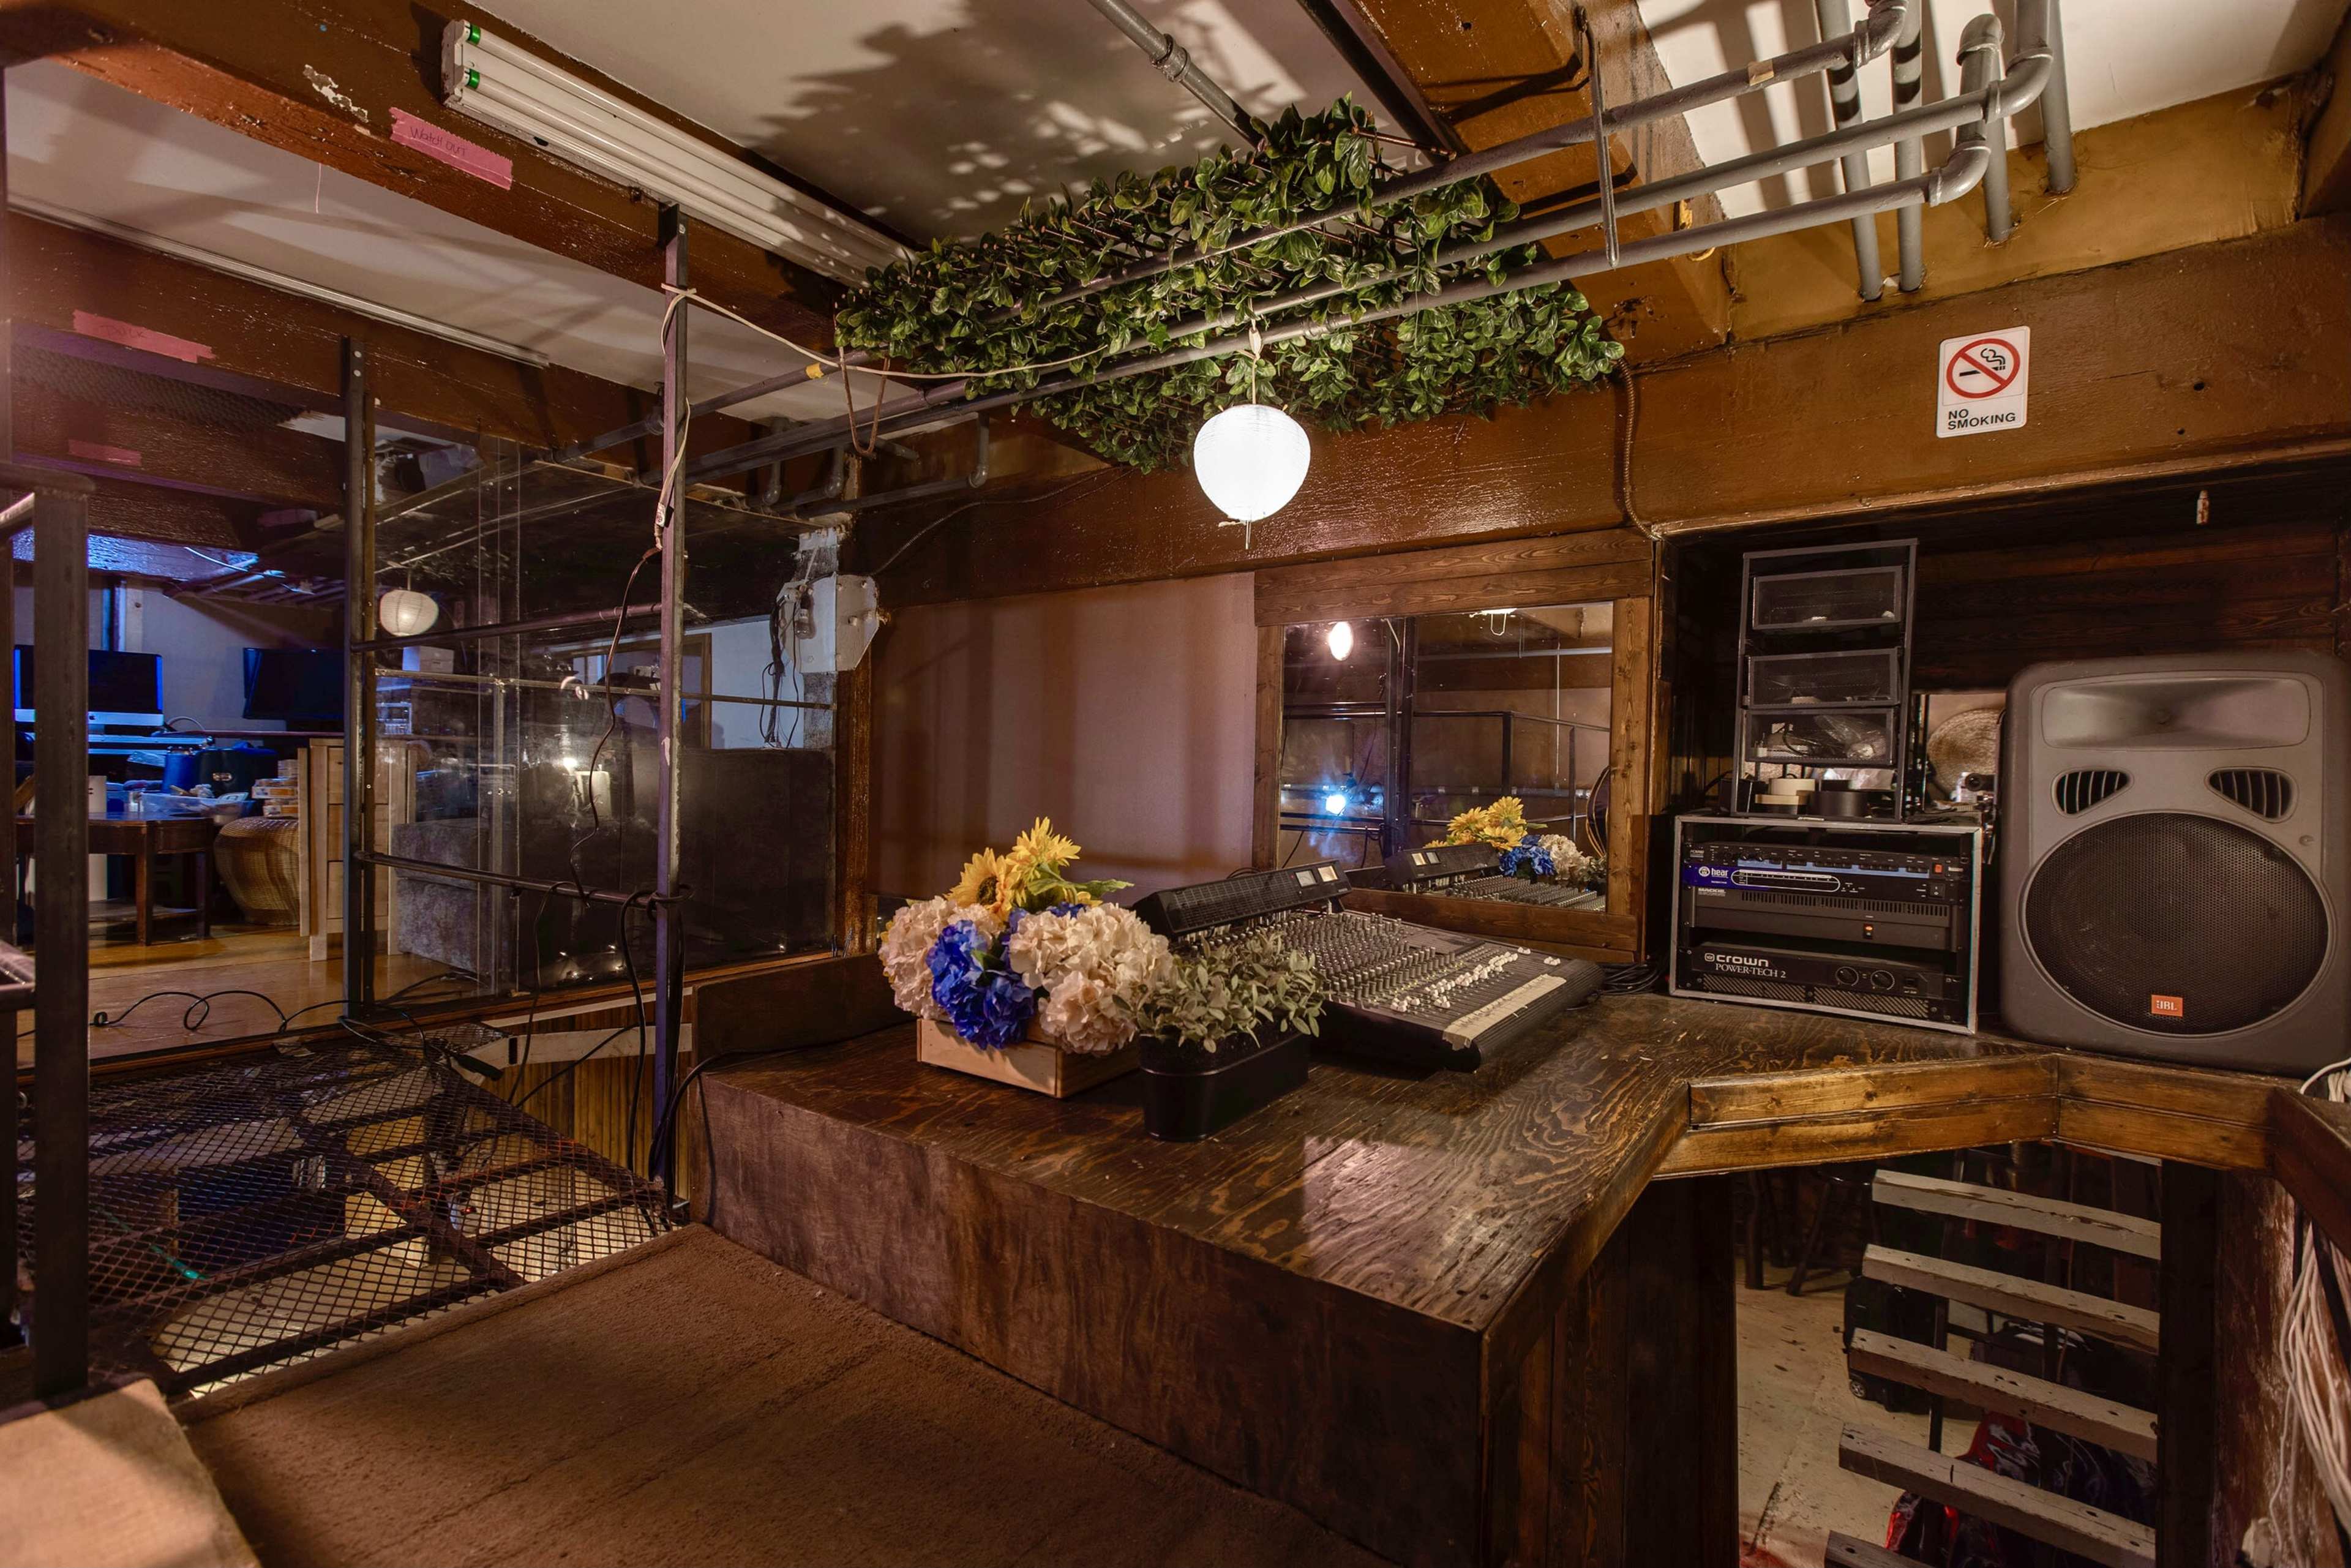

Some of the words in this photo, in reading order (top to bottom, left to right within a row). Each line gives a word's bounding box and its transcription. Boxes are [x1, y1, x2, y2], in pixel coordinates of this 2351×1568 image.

[1949, 409, 1969, 419] NO
[1948, 413, 2015, 430] SMOKING
[1711, 868, 1728, 877] hear
[1716, 955, 1769, 967] crown
[1715, 963, 1778, 977] POWER-TECH
[2156, 1000, 2178, 1010] JBL
